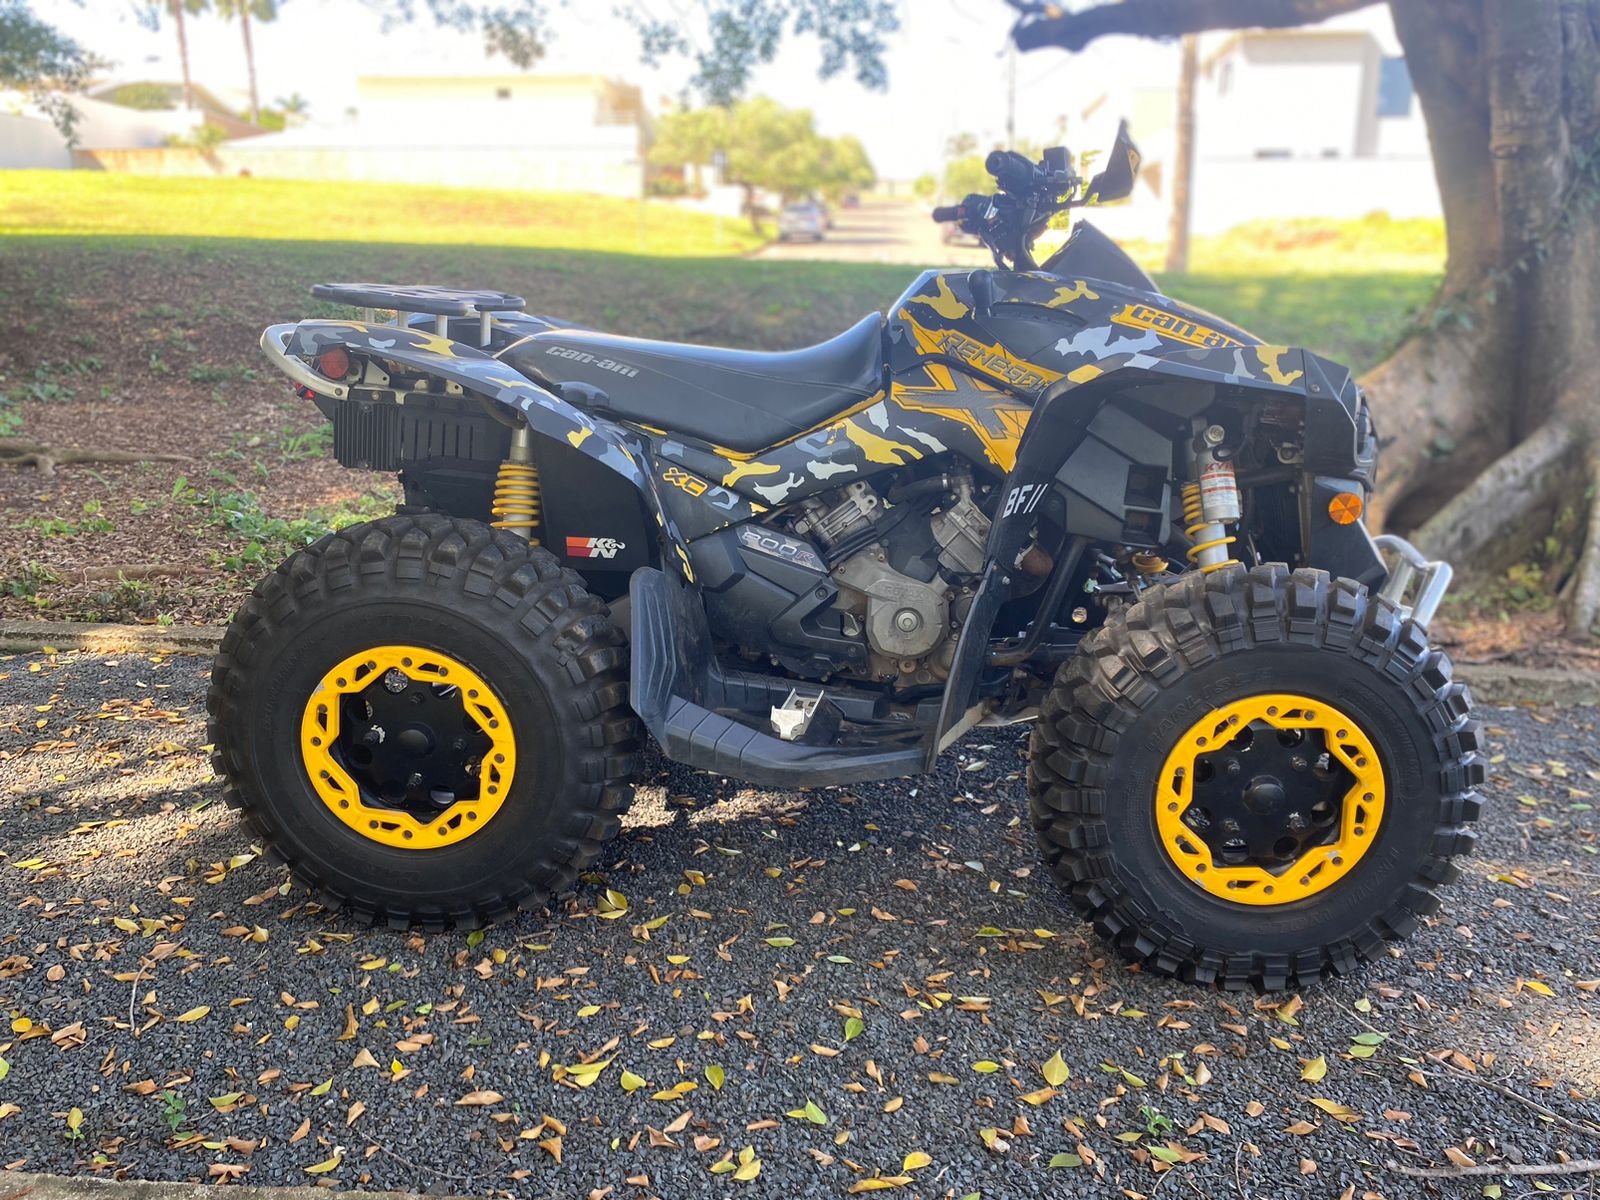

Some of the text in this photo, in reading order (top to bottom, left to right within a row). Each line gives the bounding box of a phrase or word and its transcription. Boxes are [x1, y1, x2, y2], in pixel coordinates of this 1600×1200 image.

[1131, 306, 1235, 347] can-a
[545, 346, 640, 378] can-am
[937, 333, 1051, 392] RENEGA
[586, 537, 626, 559] K&N
[742, 531, 816, 562] 800R
